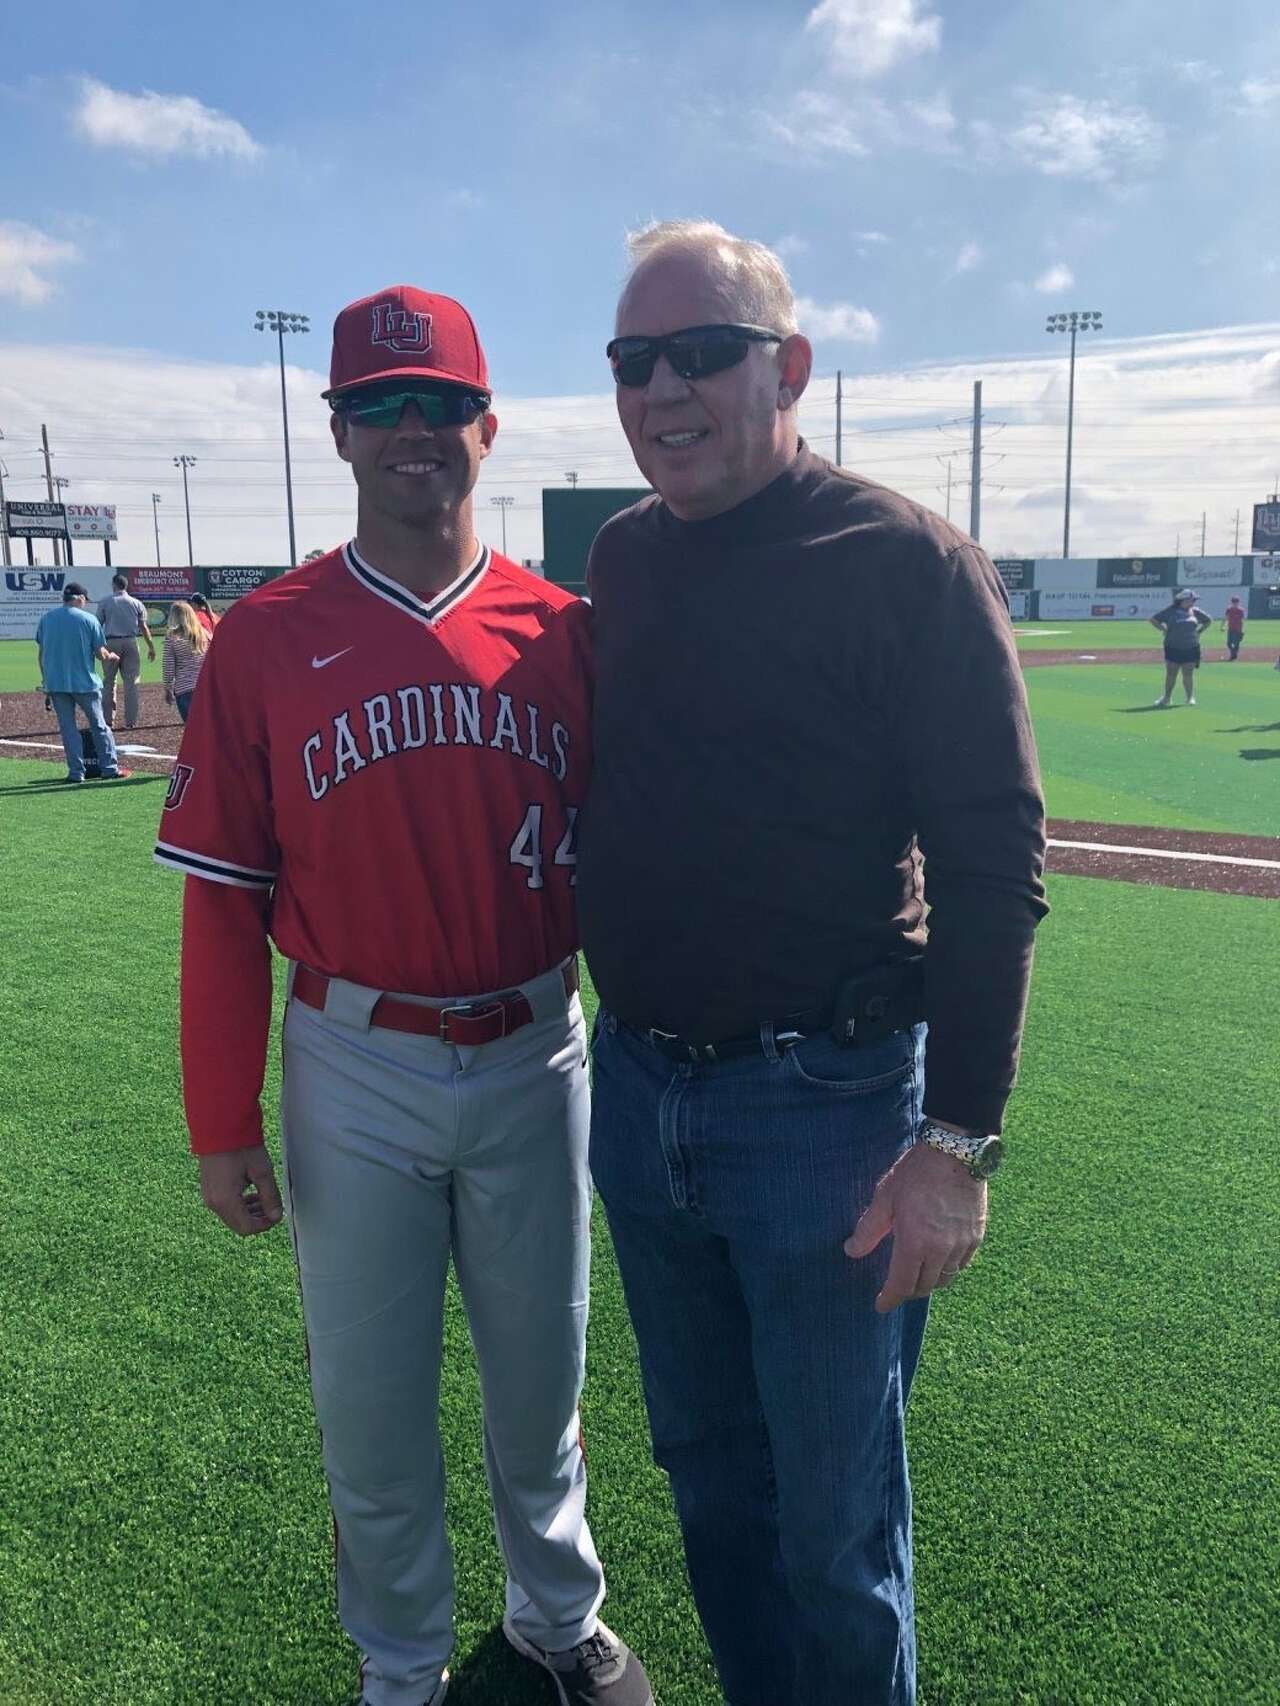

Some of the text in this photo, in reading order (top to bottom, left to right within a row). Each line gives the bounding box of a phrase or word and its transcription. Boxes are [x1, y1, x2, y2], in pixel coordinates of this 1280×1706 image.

[372, 303, 433, 354] LU
[67, 505, 99, 516] STAY
[139, 569, 183, 578] BEAUMONT
[222, 569, 262, 577] COTTON
[225, 576, 261, 585] CARGO
[5, 573, 65, 592] USW
[302, 683, 571, 801] CARDINALS
[509, 803, 577, 890] 44
